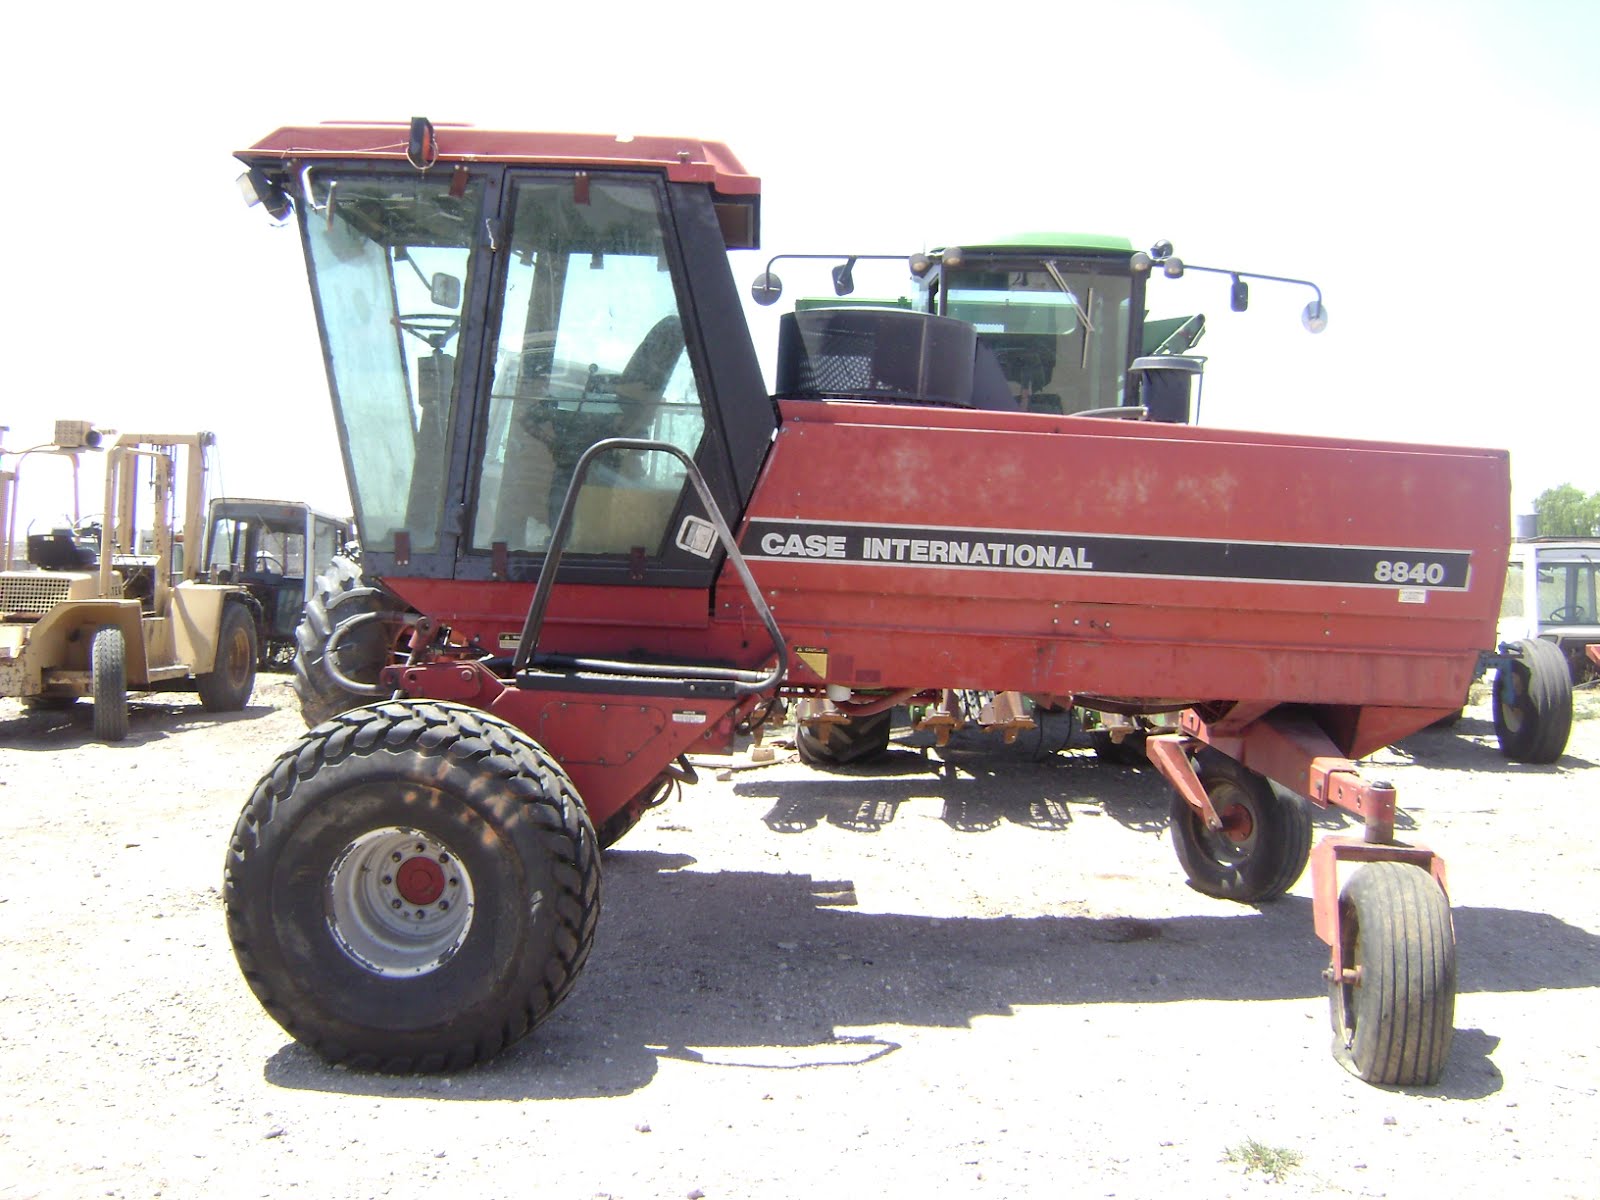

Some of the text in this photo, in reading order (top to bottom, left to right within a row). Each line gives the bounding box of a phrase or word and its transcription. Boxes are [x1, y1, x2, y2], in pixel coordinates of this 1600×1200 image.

[761, 532, 1093, 569] CASE INTERNATIONAL
[1374, 560, 1444, 584] 8840
